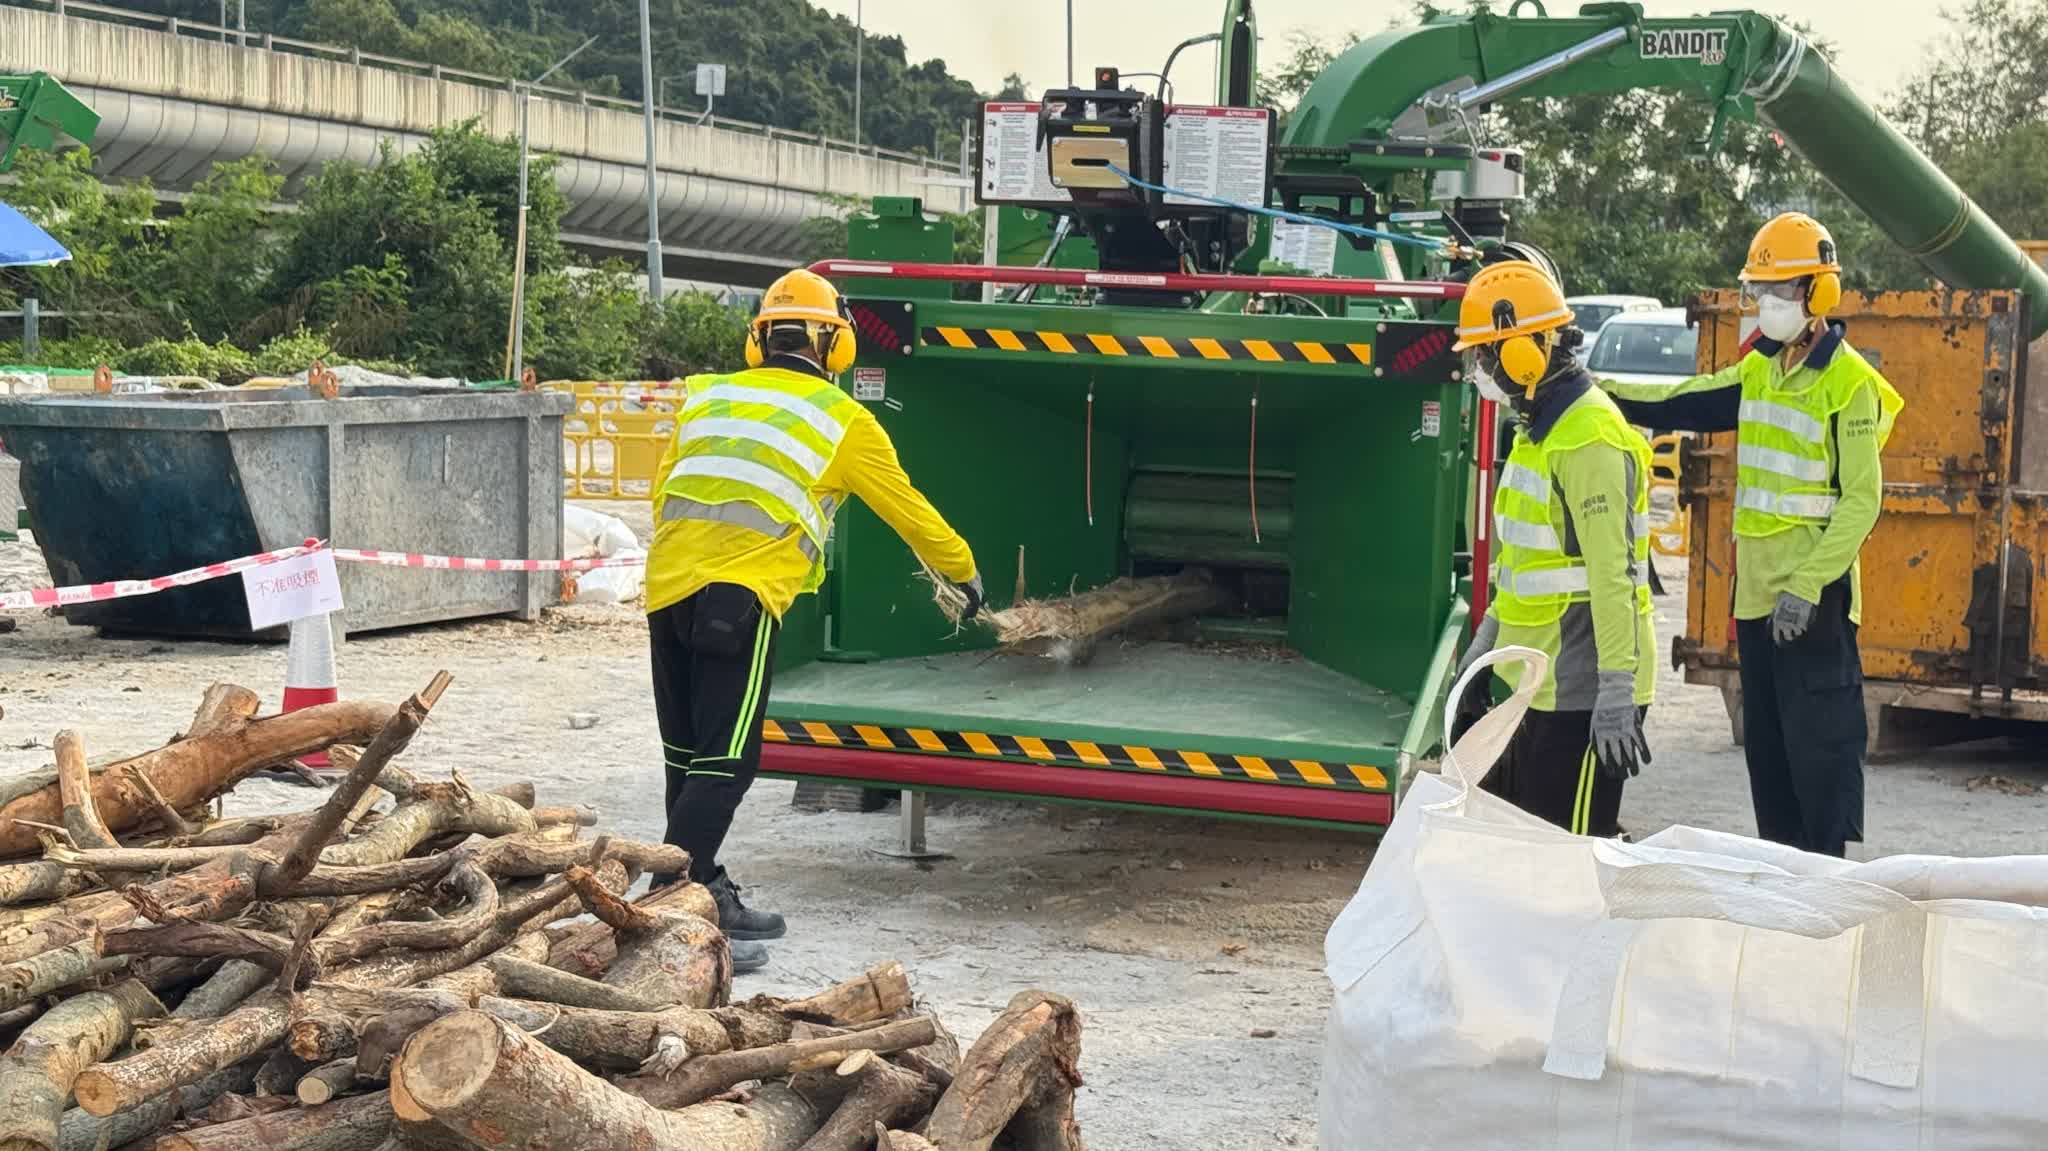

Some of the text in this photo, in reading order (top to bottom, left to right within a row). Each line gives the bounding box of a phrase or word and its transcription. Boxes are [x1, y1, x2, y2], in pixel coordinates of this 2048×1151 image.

[1642, 31, 1726, 55] BANDIT
[255, 568, 321, 597] 不准吸煙
